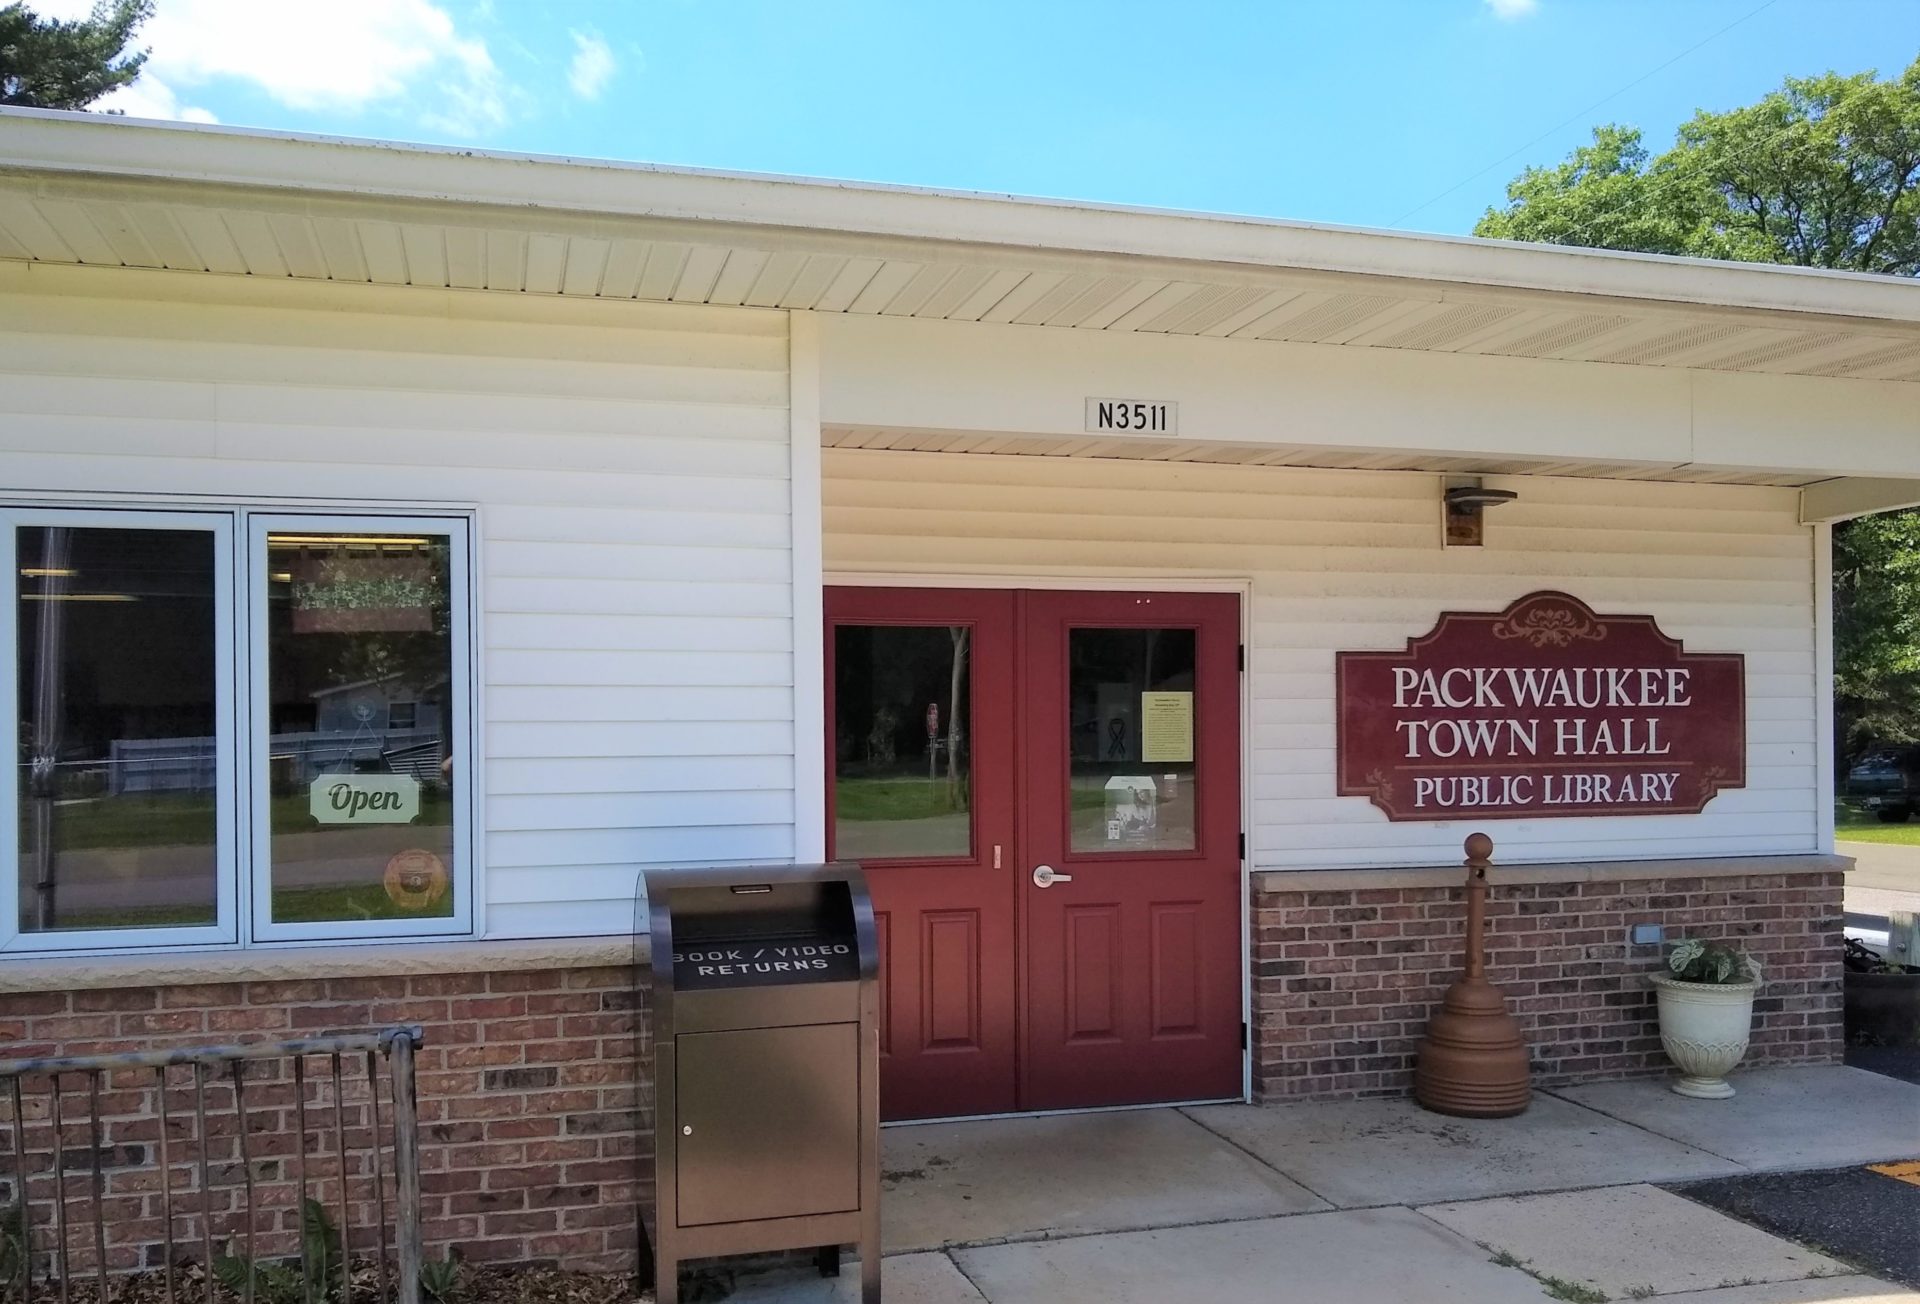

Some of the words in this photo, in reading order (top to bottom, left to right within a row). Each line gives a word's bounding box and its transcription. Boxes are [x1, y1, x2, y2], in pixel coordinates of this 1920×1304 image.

[1099, 402, 1166, 430] N3511
[1392, 667, 1692, 708] PACKWAUKEE
[1395, 719, 1539, 758] TOWN
[1553, 718, 1671, 756] HALL
[328, 783, 402, 818] Open
[1413, 775, 1534, 808] PUBLIC
[1542, 772, 1680, 805] LIBRARY
[672, 950, 743, 963] BOOK
[775, 944, 849, 957] VIDEO
[698, 958, 828, 976] RETURNS
